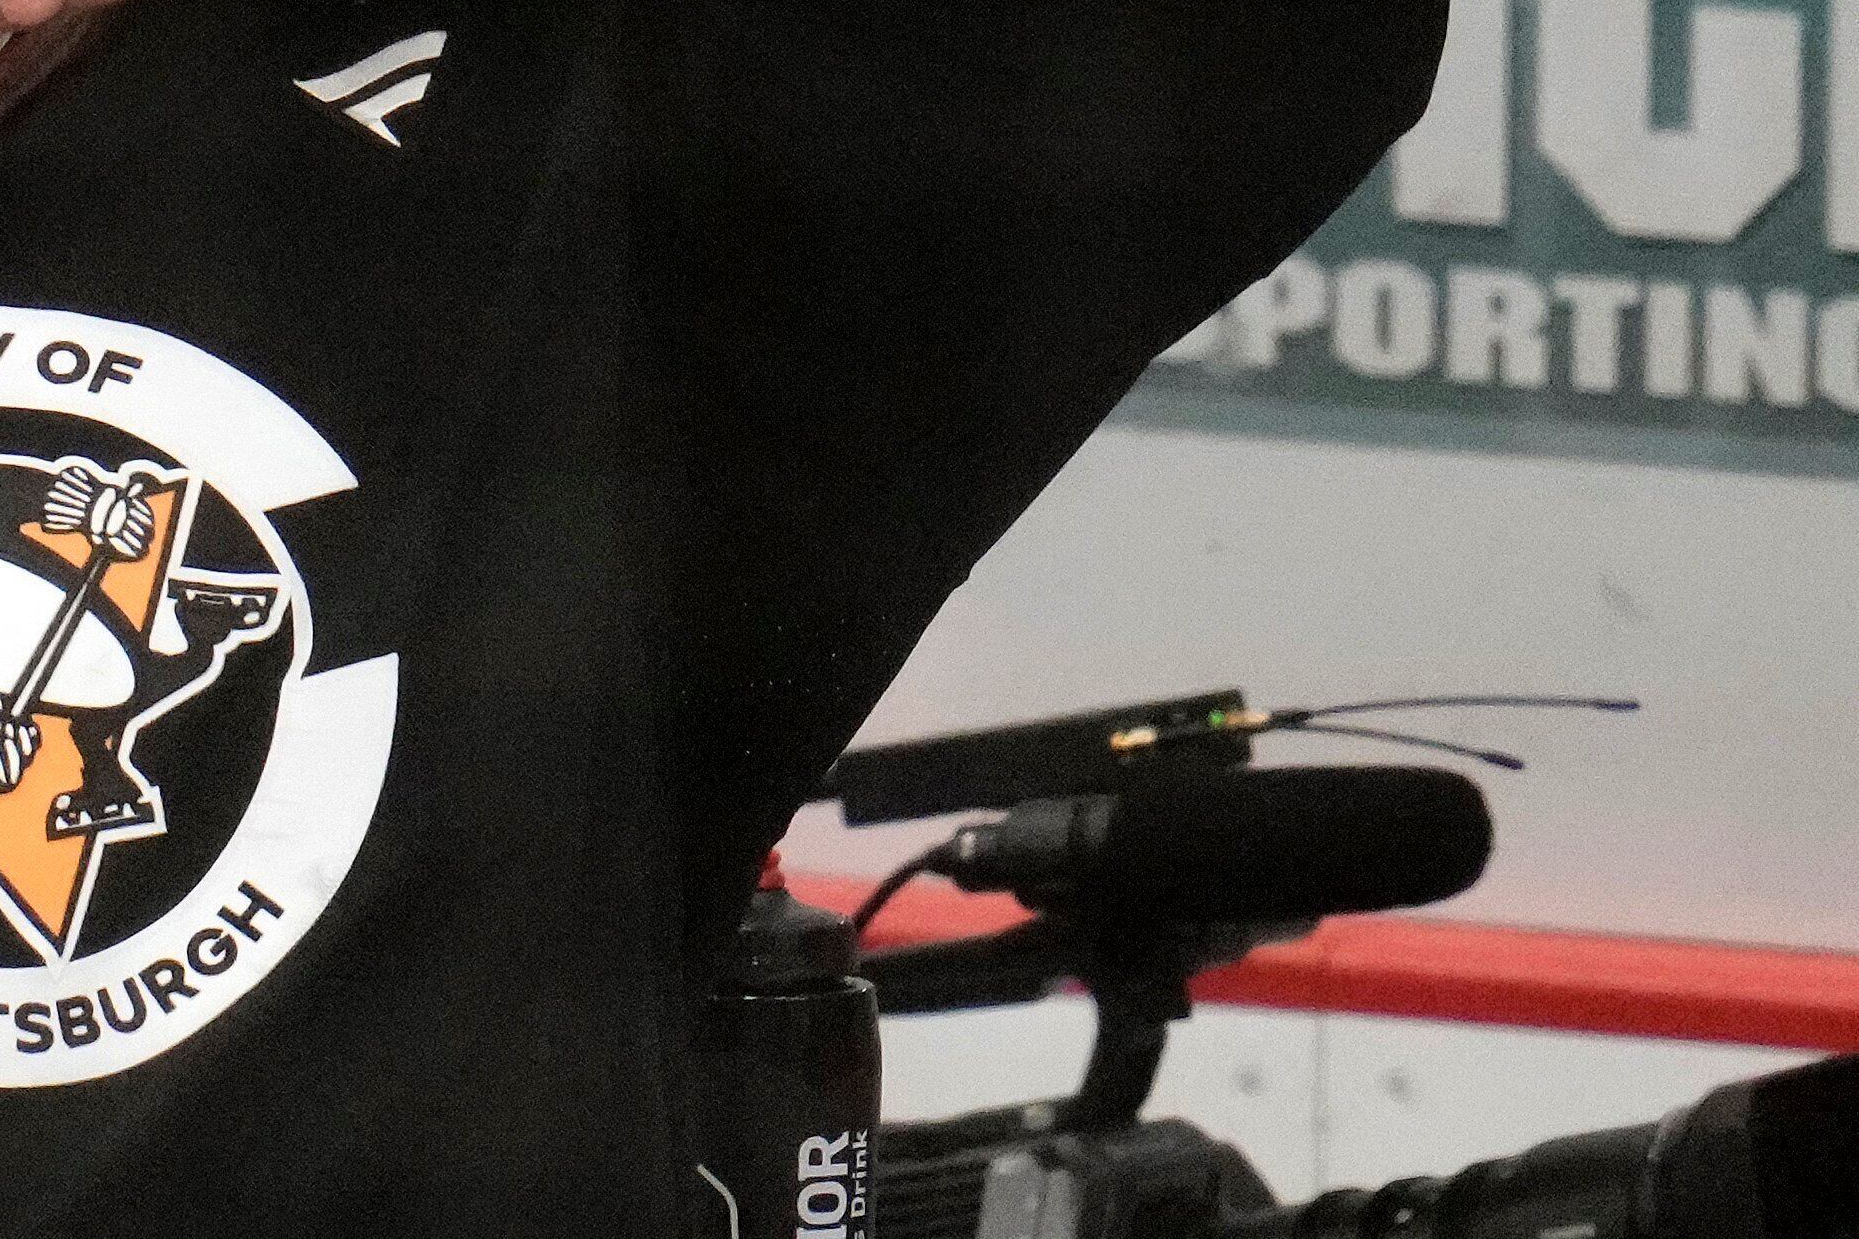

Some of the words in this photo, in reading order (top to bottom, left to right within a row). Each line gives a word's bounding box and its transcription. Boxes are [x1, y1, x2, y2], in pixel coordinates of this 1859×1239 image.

[37, 338, 144, 396] OF
[796, 1130, 849, 1239] OR
[849, 1128, 868, 1219] Drink
